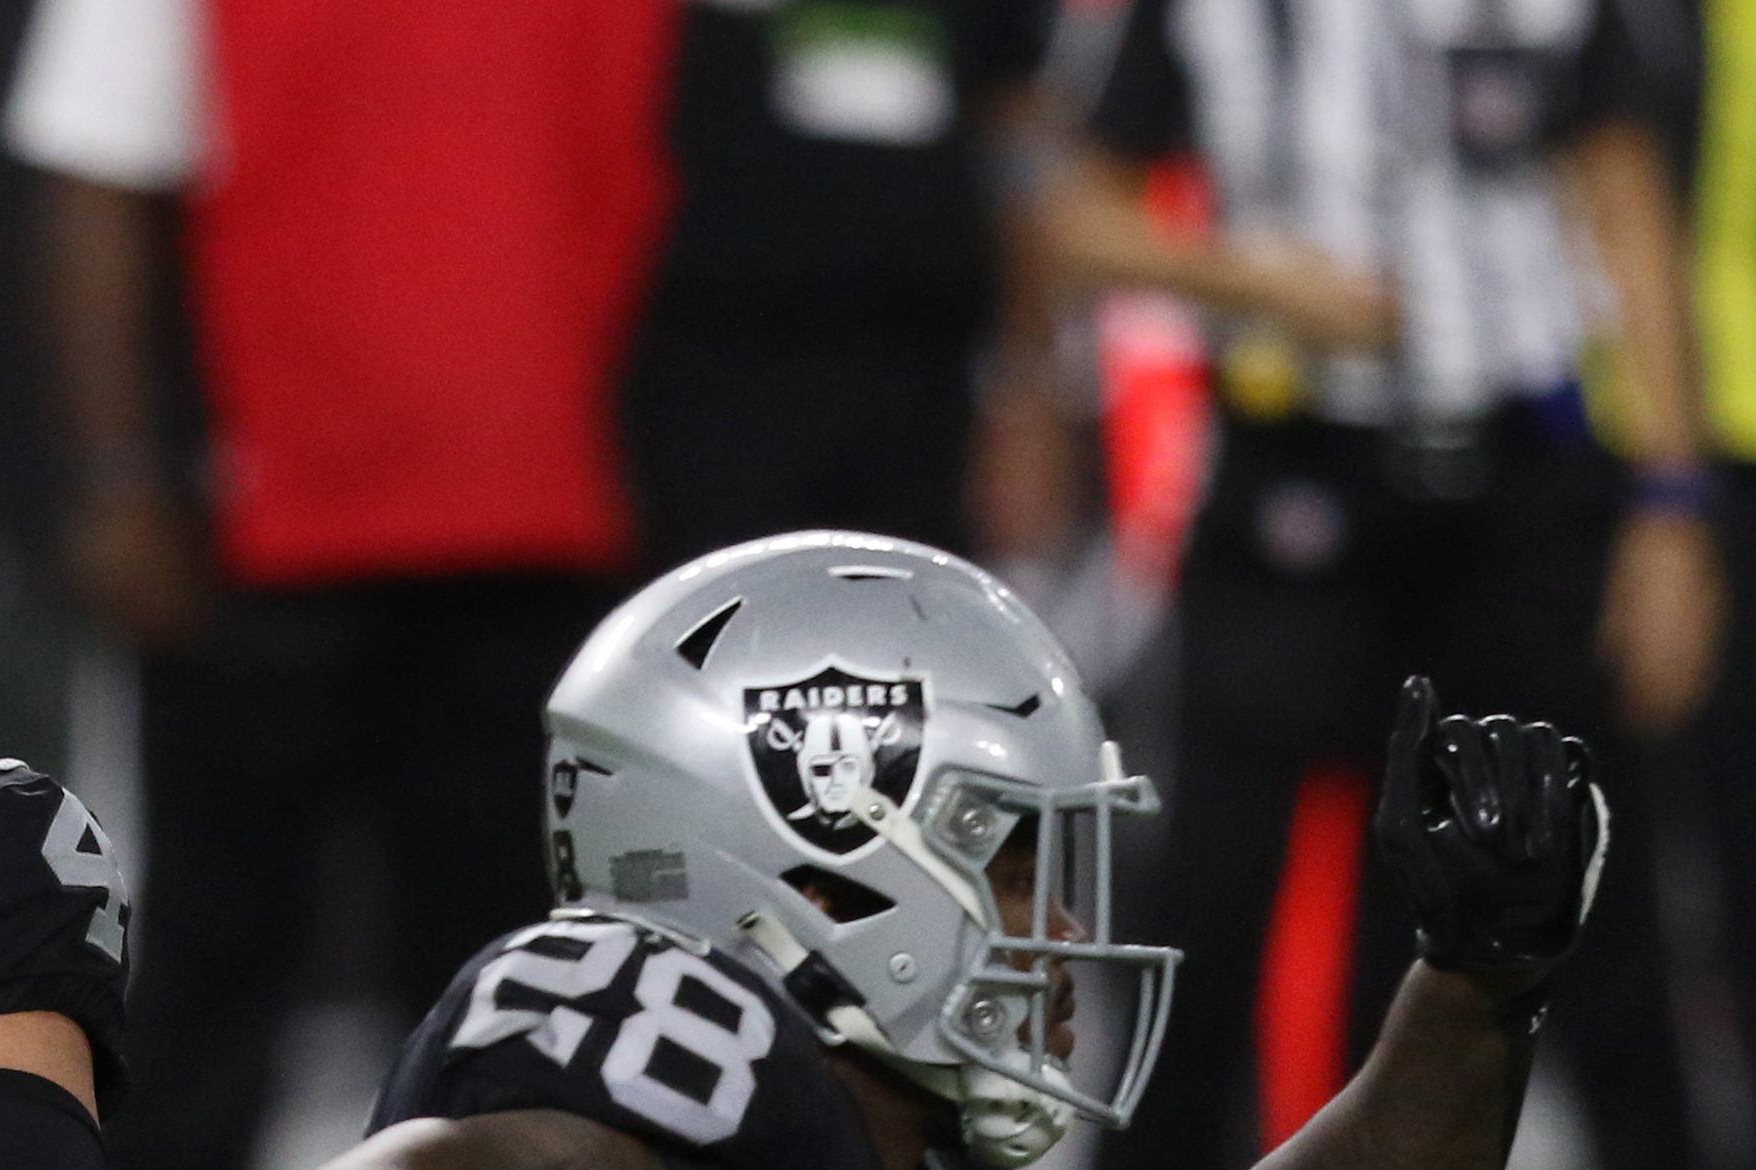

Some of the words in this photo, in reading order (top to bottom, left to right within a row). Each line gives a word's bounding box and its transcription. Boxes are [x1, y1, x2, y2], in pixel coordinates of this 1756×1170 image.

[759, 684, 908, 712] RAIDERS
[41, 786, 129, 965] 4
[449, 920, 777, 1147] 28
